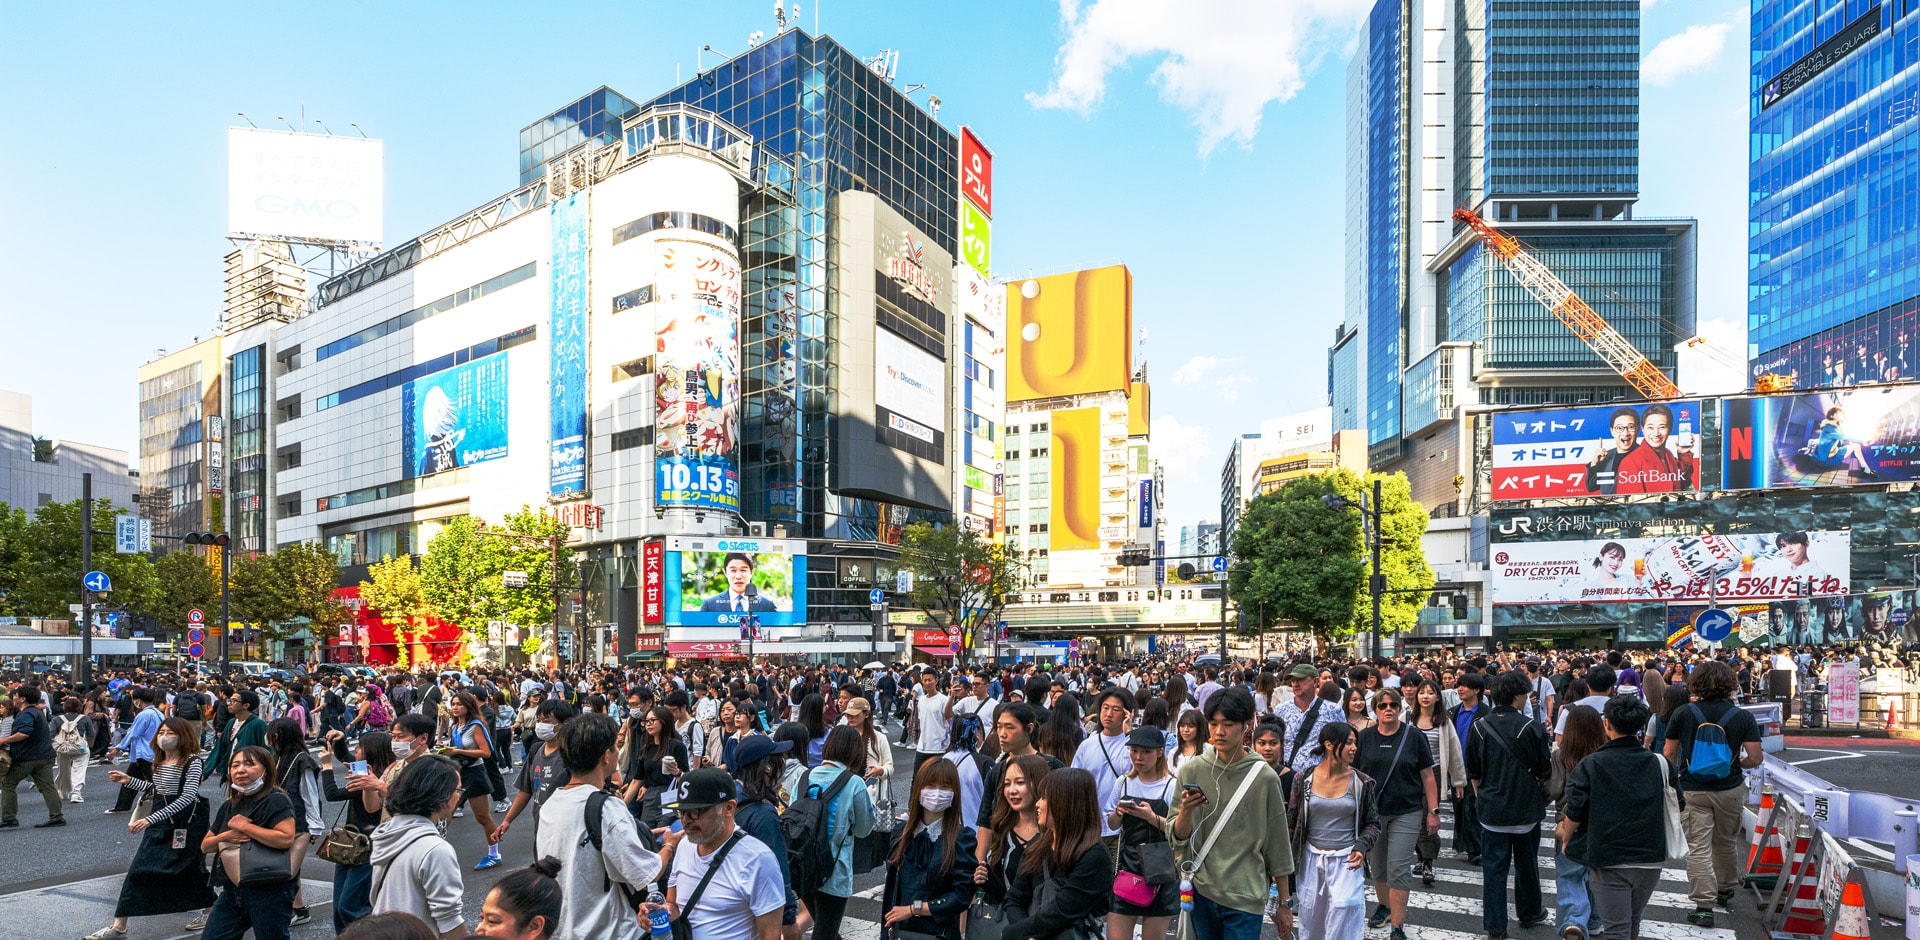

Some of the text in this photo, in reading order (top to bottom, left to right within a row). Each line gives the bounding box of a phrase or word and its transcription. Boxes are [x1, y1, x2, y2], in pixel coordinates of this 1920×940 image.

[1781, 22, 1877, 94] SCRAMBLE SQUARE
[1782, 51, 1823, 84] SHIBUYA
[255, 151, 361, 173] すべての人に
[255, 169, 361, 190] インターネット
[964, 166, 989, 205] アコム
[254, 194, 360, 220] GMO
[964, 205, 985, 264] レイク
[889, 258, 936, 303] MAGNET
[1763, 358, 1788, 371] Spotify
[1278, 424, 1314, 439] TSEI
[1530, 418, 1585, 434] オトク
[1511, 446, 1585, 462] オドロク
[1730, 427, 1752, 460] N
[660, 463, 723, 494] 10.13
[1498, 472, 1585, 490] ペイトク
[1618, 469, 1686, 484] SoftBank
[550, 504, 604, 529] AGNET
[1500, 514, 1686, 534] JR 渋谷駅 shibuya station
[125, 518, 135, 551] 渋谷駅前
[1504, 566, 1581, 577] DRY CRYSTAL
[647, 557, 659, 617] 天津甘栗
[679, 781, 690, 800] S
